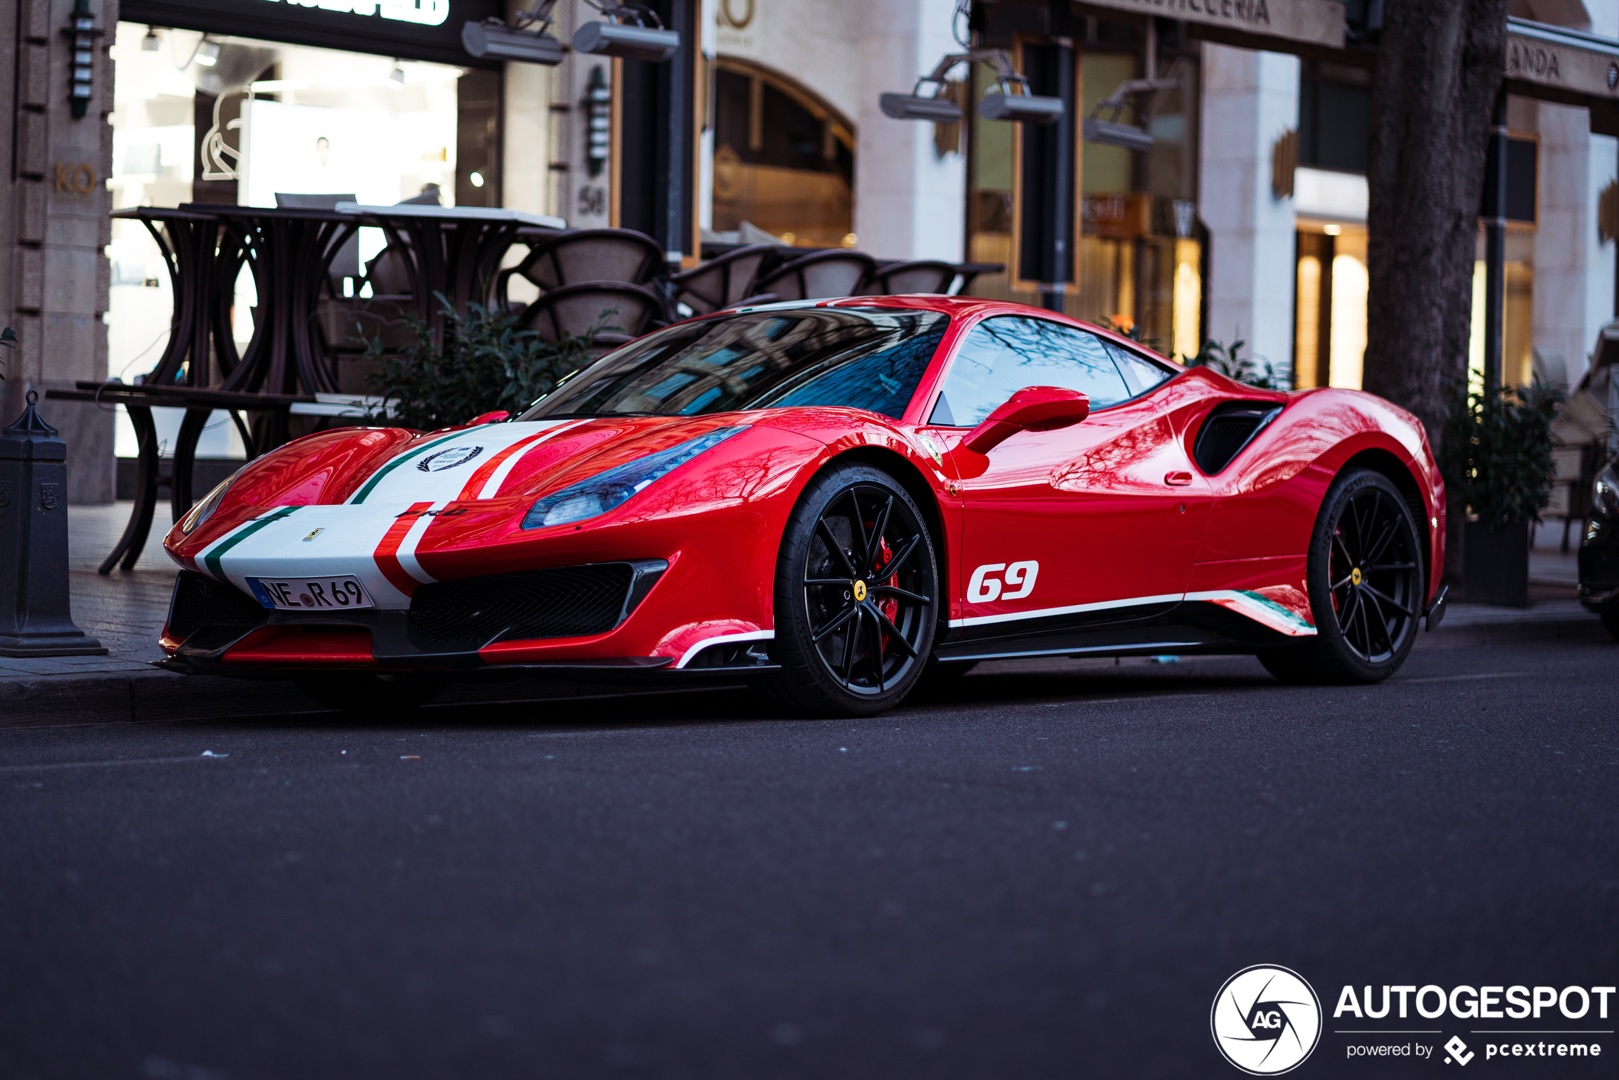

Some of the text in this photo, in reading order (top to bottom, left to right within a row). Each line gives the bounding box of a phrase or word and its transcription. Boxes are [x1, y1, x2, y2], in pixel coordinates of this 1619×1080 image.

[261, 580, 362, 606] NE R 69
[966, 559, 1040, 604] 69
